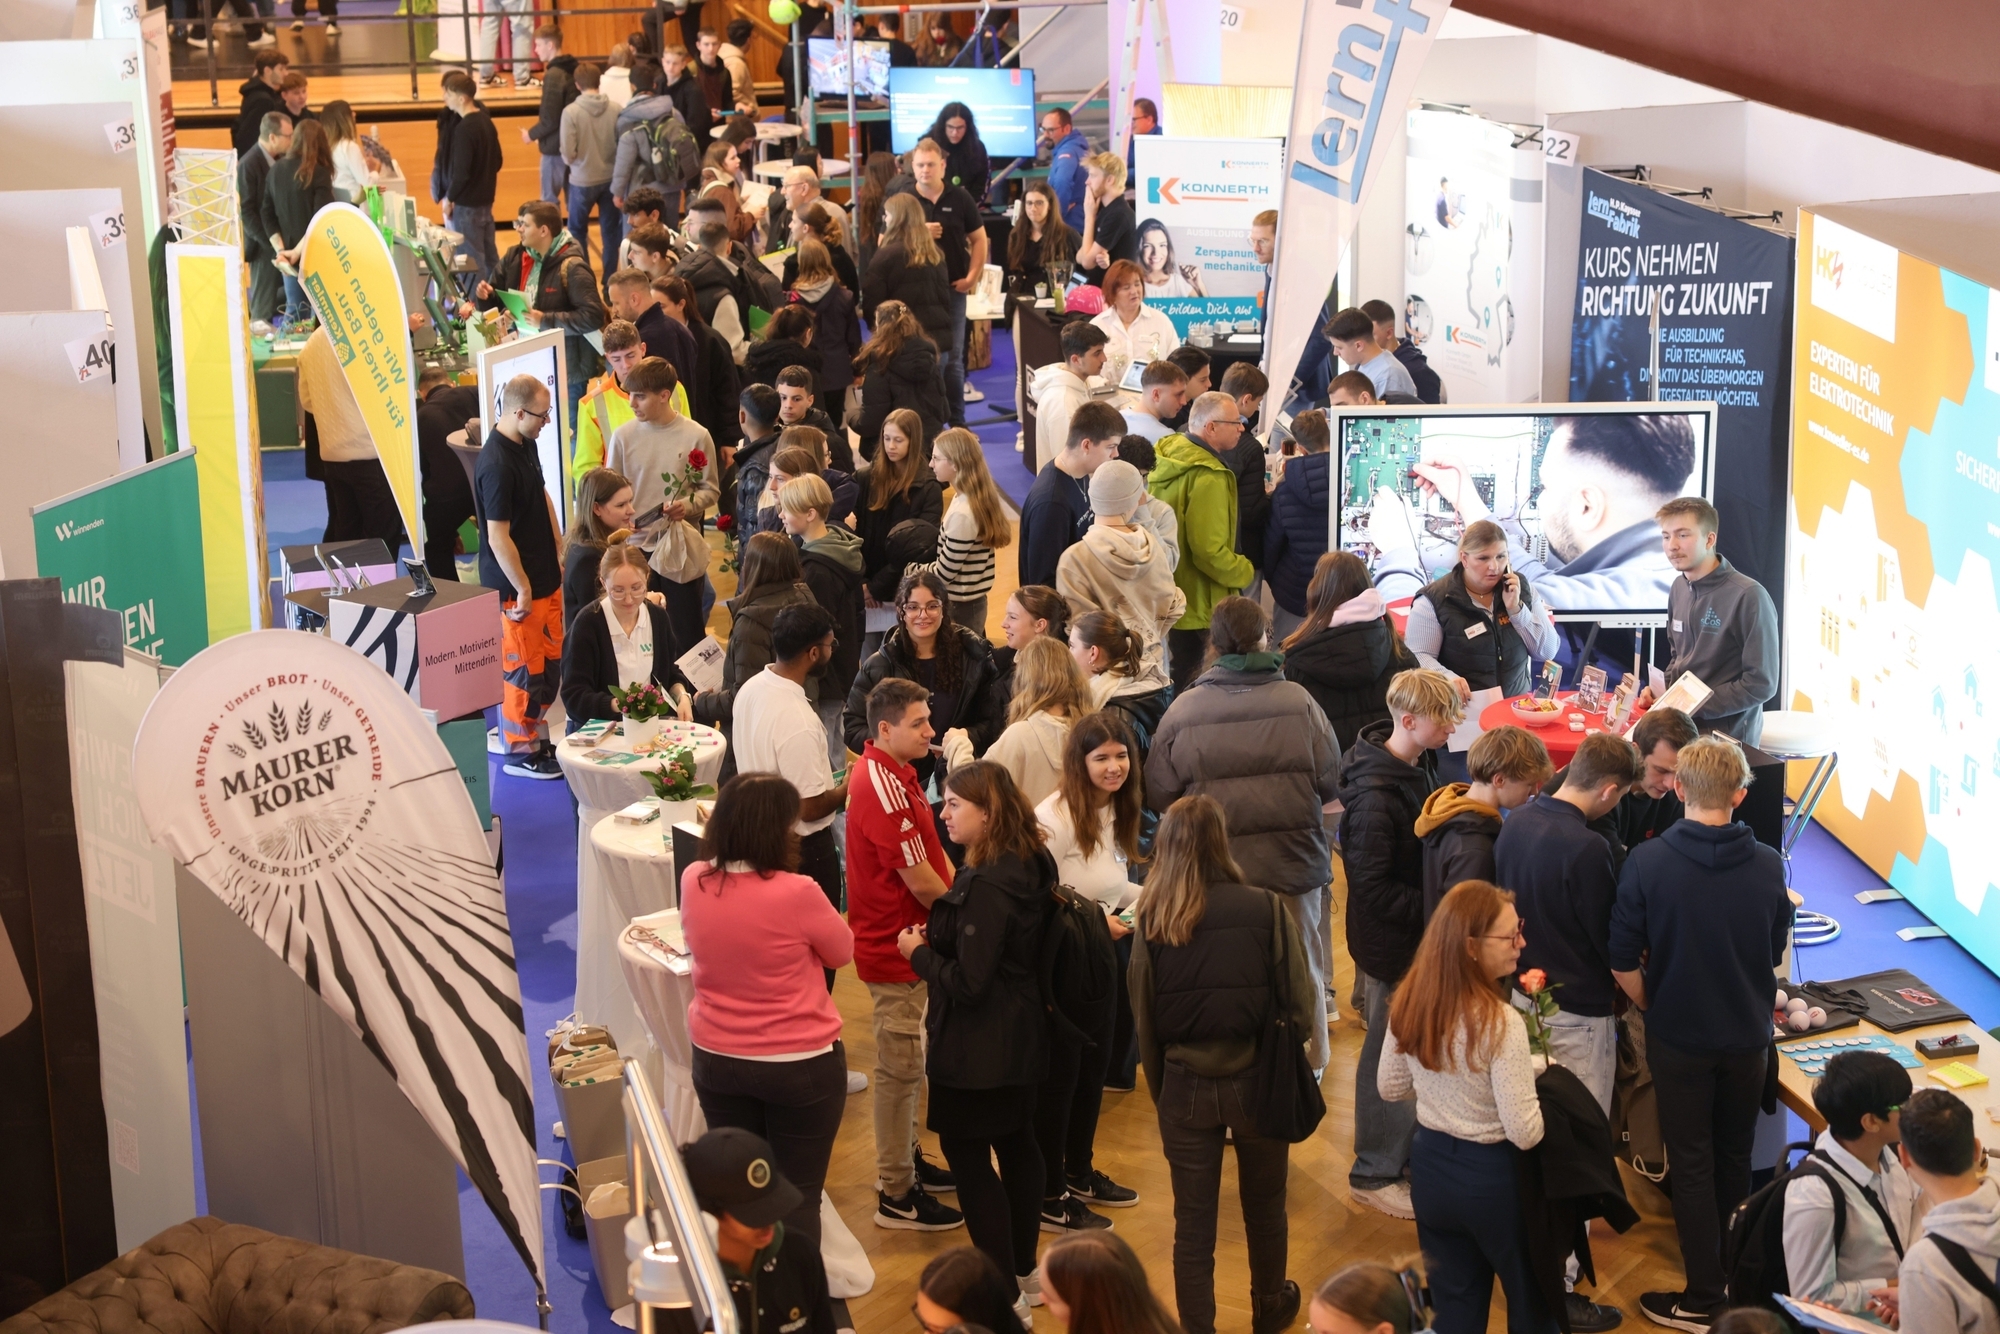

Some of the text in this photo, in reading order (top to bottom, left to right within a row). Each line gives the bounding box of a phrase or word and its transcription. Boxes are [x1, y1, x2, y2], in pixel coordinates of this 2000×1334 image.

[1220, 9, 1238, 26] 20
[1546, 137, 1571, 159] 22
[1181, 183, 1269, 195] KONNERTH
[1186, 229, 1244, 239] AUSBILDUNG
[1607, 209, 1641, 239] Fabrik
[1584, 242, 1719, 278] KURS NEHMEN
[1168, 302, 1204, 315] bilden
[1206, 302, 1232, 315] Dich
[1234, 304, 1253, 315] aus
[1581, 281, 1773, 317] RICHTUNG ZUKUNFT
[1668, 328, 1725, 343] AUSBILDUNG
[86, 340, 110, 368] 40
[1665, 345, 1746, 367] FÜR TECHNIKFANS,
[1682, 369, 1699, 383] DAS
[1701, 366, 1764, 386] ÜBERMORGEN
[1811, 340, 1880, 396] EXPERTEN FÜR
[1658, 387, 1760, 407] ITGESTALTEN MÖCHTEN.
[1810, 371, 1894, 437] ELEKTROTECHNIK
[73, 518, 104, 536] winnenden
[62, 576, 107, 610] WIR
[425, 637, 497, 667] Modern. Motiviert.
[454, 654, 497, 675] Mittendrin.
[195, 673, 382, 839] Unsere BAUERN Unser BROT Unser GETREIDE
[220, 734, 358, 801] MAURER
[328, 833, 355, 863] SEIT
[355, 799, 377, 832] 1994
